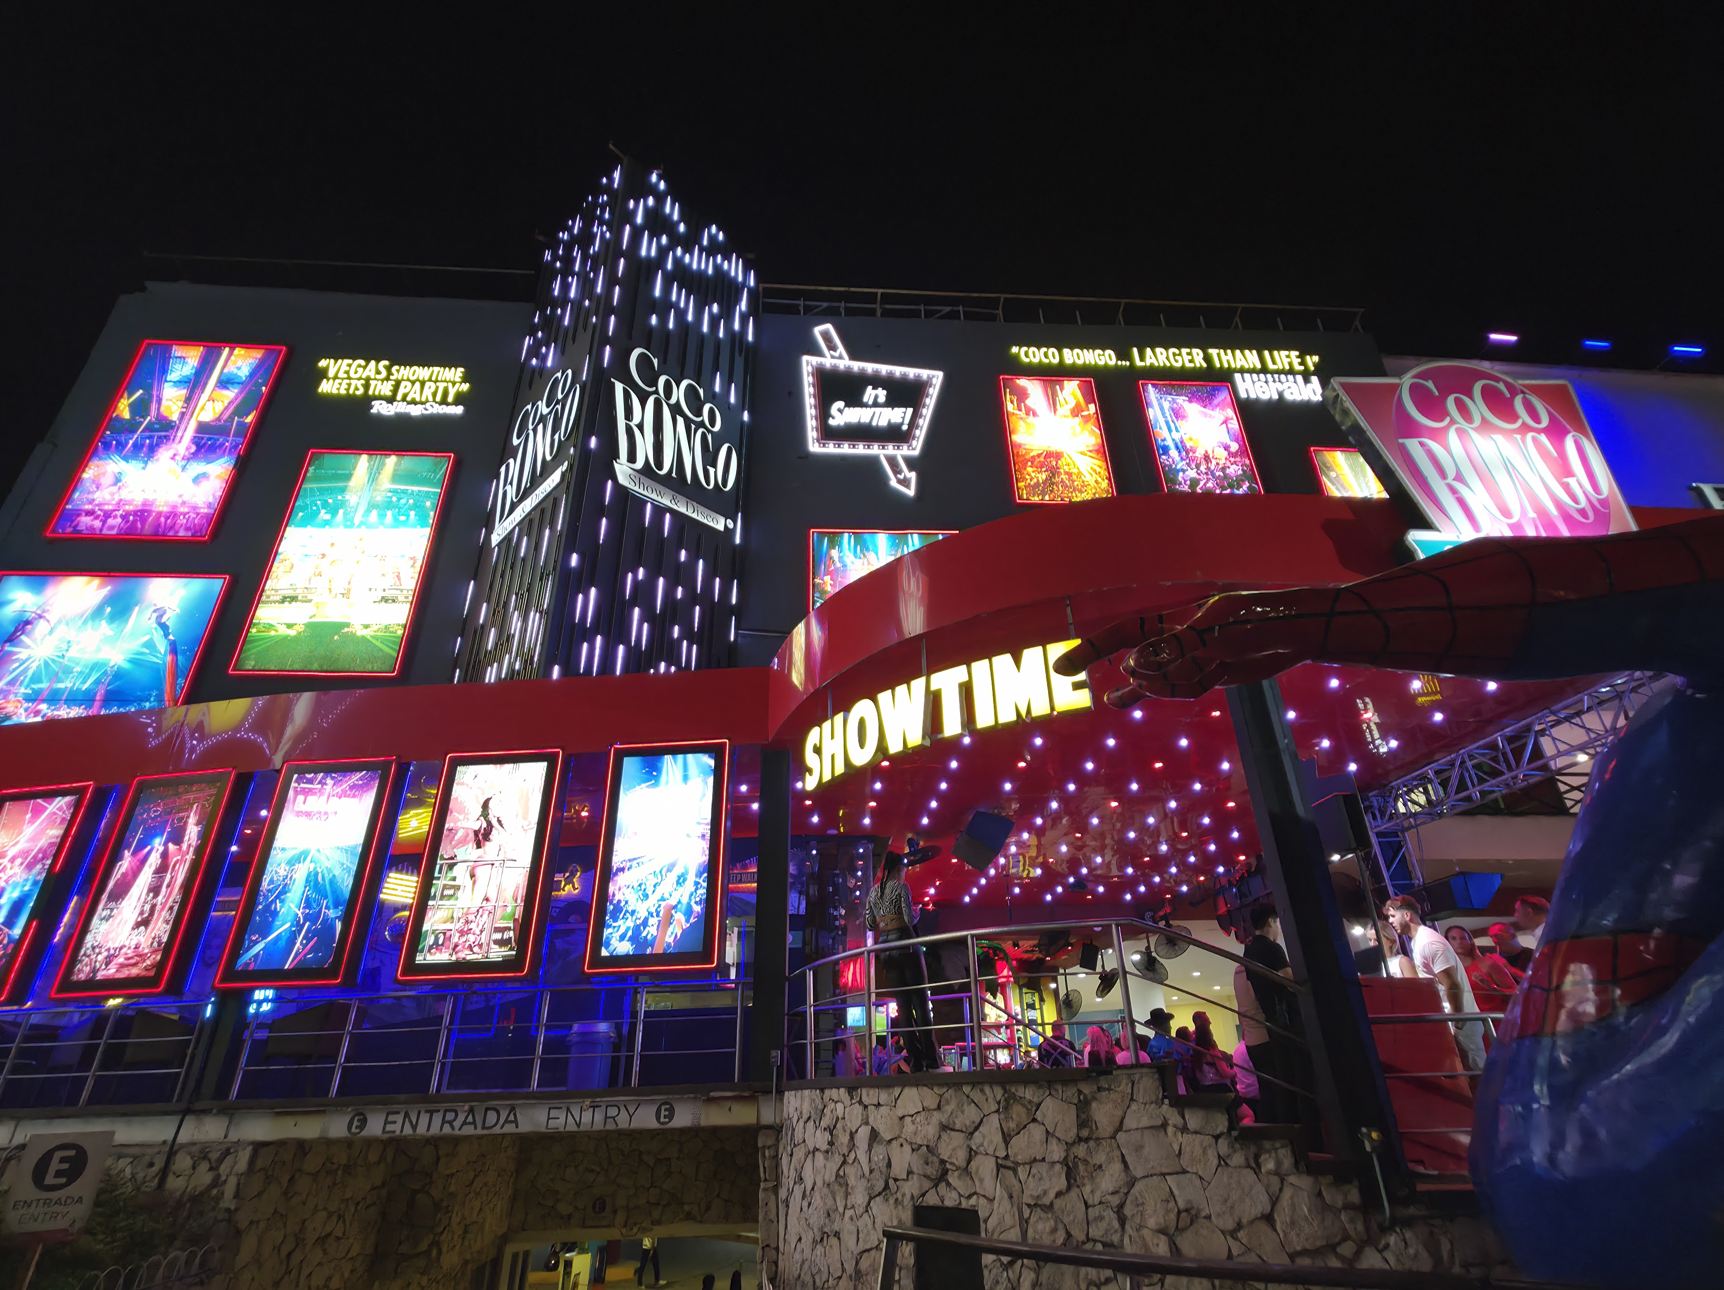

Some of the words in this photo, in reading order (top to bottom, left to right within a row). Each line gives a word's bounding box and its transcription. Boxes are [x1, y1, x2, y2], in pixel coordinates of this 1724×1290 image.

[1132, 347, 1207, 367] LARGER
[1207, 349, 1261, 369] THAN
[318, 379, 365, 395] MEETS
[368, 380, 395, 396] THE
[390, 366, 464, 382] SHOWTIME
[1234, 373, 1323, 401] Herald
[611, 377, 737, 491] BONGO
[494, 383, 579, 532] BONGO
[1397, 424, 1609, 538] BONGO
[628, 473, 666, 500] Show
[669, 494, 681, 509] &
[685, 500, 719, 526] Disco
[804, 638, 1092, 791] SHOWTIME
[382, 1106, 520, 1135] ENTRADA
[545, 1103, 641, 1131] ENTRY
[12, 1195, 84, 1211] ENTRADA
[18, 1210, 70, 1225] ENTRY
